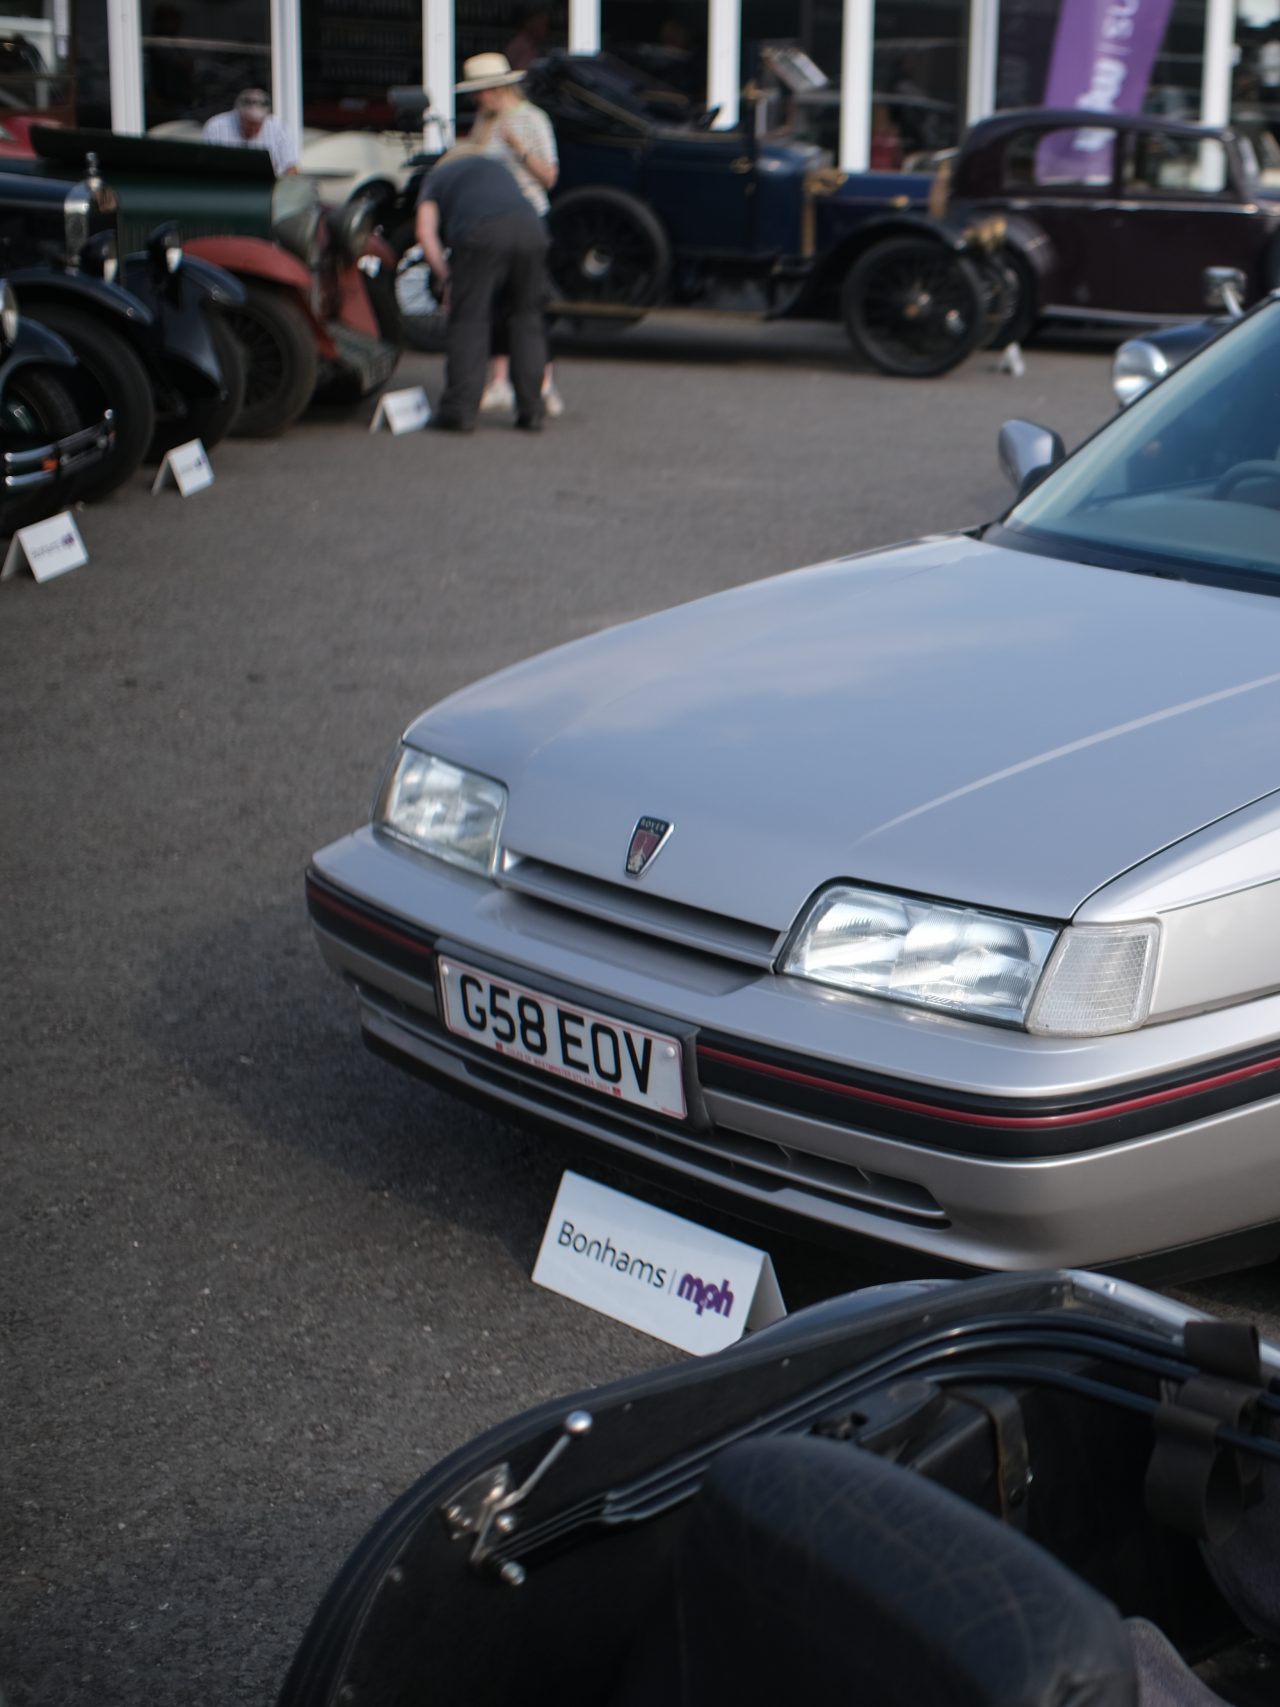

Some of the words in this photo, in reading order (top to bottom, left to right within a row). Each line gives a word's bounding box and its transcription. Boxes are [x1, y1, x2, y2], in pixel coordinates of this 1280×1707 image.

[460, 974, 548, 1056] G58
[557, 1007, 653, 1095] EOV
[557, 1220, 668, 1288] Bonhams
[677, 1272, 735, 1318] mph
